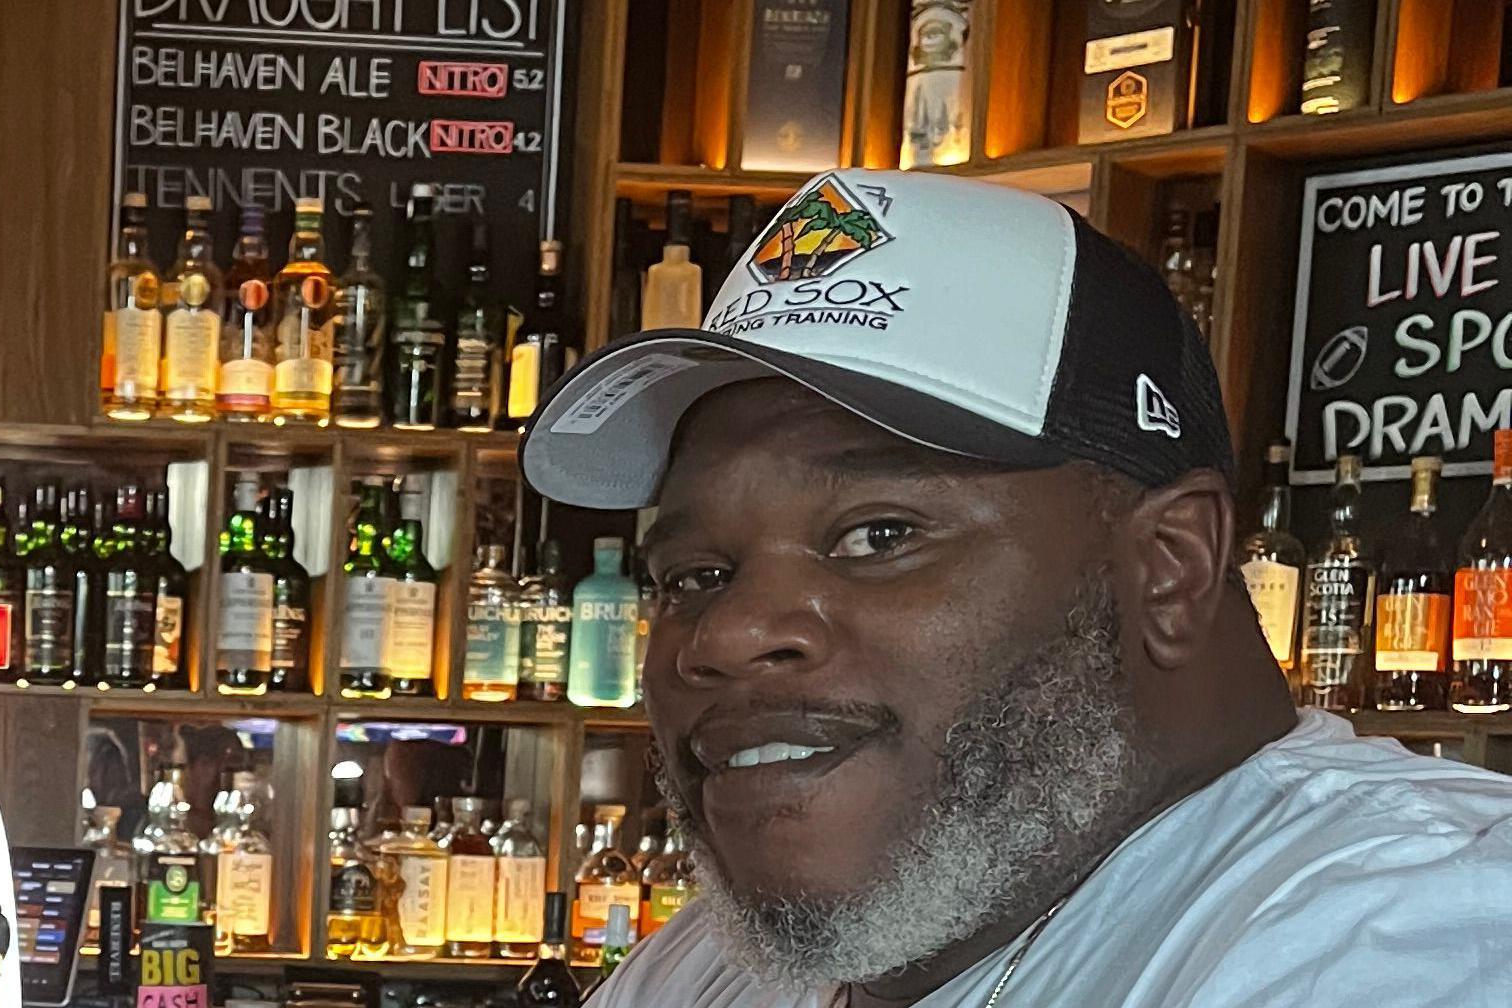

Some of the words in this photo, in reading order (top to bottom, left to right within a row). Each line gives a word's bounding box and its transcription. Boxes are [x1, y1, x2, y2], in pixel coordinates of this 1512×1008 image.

[132, 46, 305, 91] BELHAVEN
[319, 57, 393, 98] ALE
[422, 64, 505, 93] NITRO
[130, 105, 305, 150] BELHAVEN
[317, 114, 432, 159] BLACK
[436, 122, 509, 151] NITRO
[1317, 186, 1427, 233] COME
[1440, 181, 1484, 219] TO
[784, 279, 910, 312] SOX
[1367, 231, 1500, 308] LIVE
[773, 311, 888, 331] TRAINING
[141, 949, 201, 986] BIG
